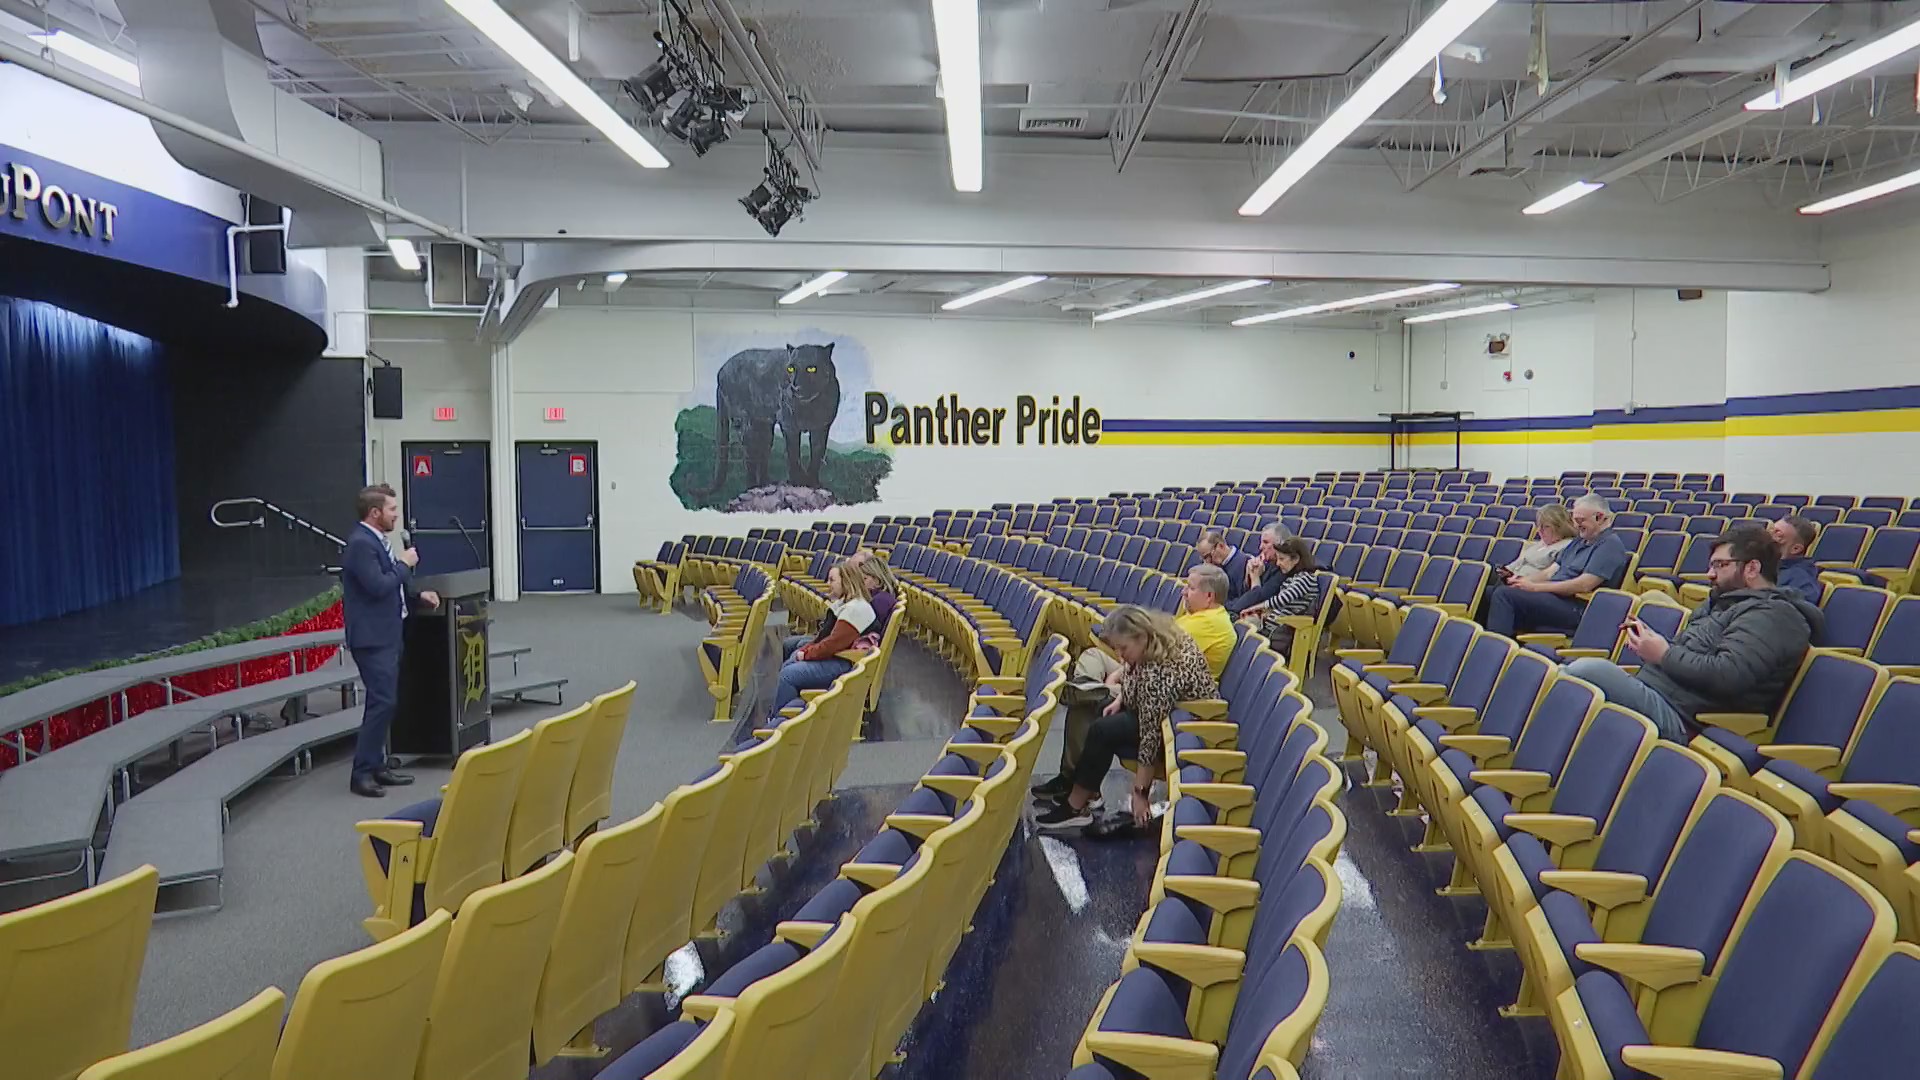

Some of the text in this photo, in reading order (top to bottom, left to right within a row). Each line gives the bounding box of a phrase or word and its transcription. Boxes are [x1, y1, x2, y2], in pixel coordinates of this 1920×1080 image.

[865, 391, 1101, 445] Panther Pride
[416, 461, 429, 474] A
[573, 459, 585, 473] B
